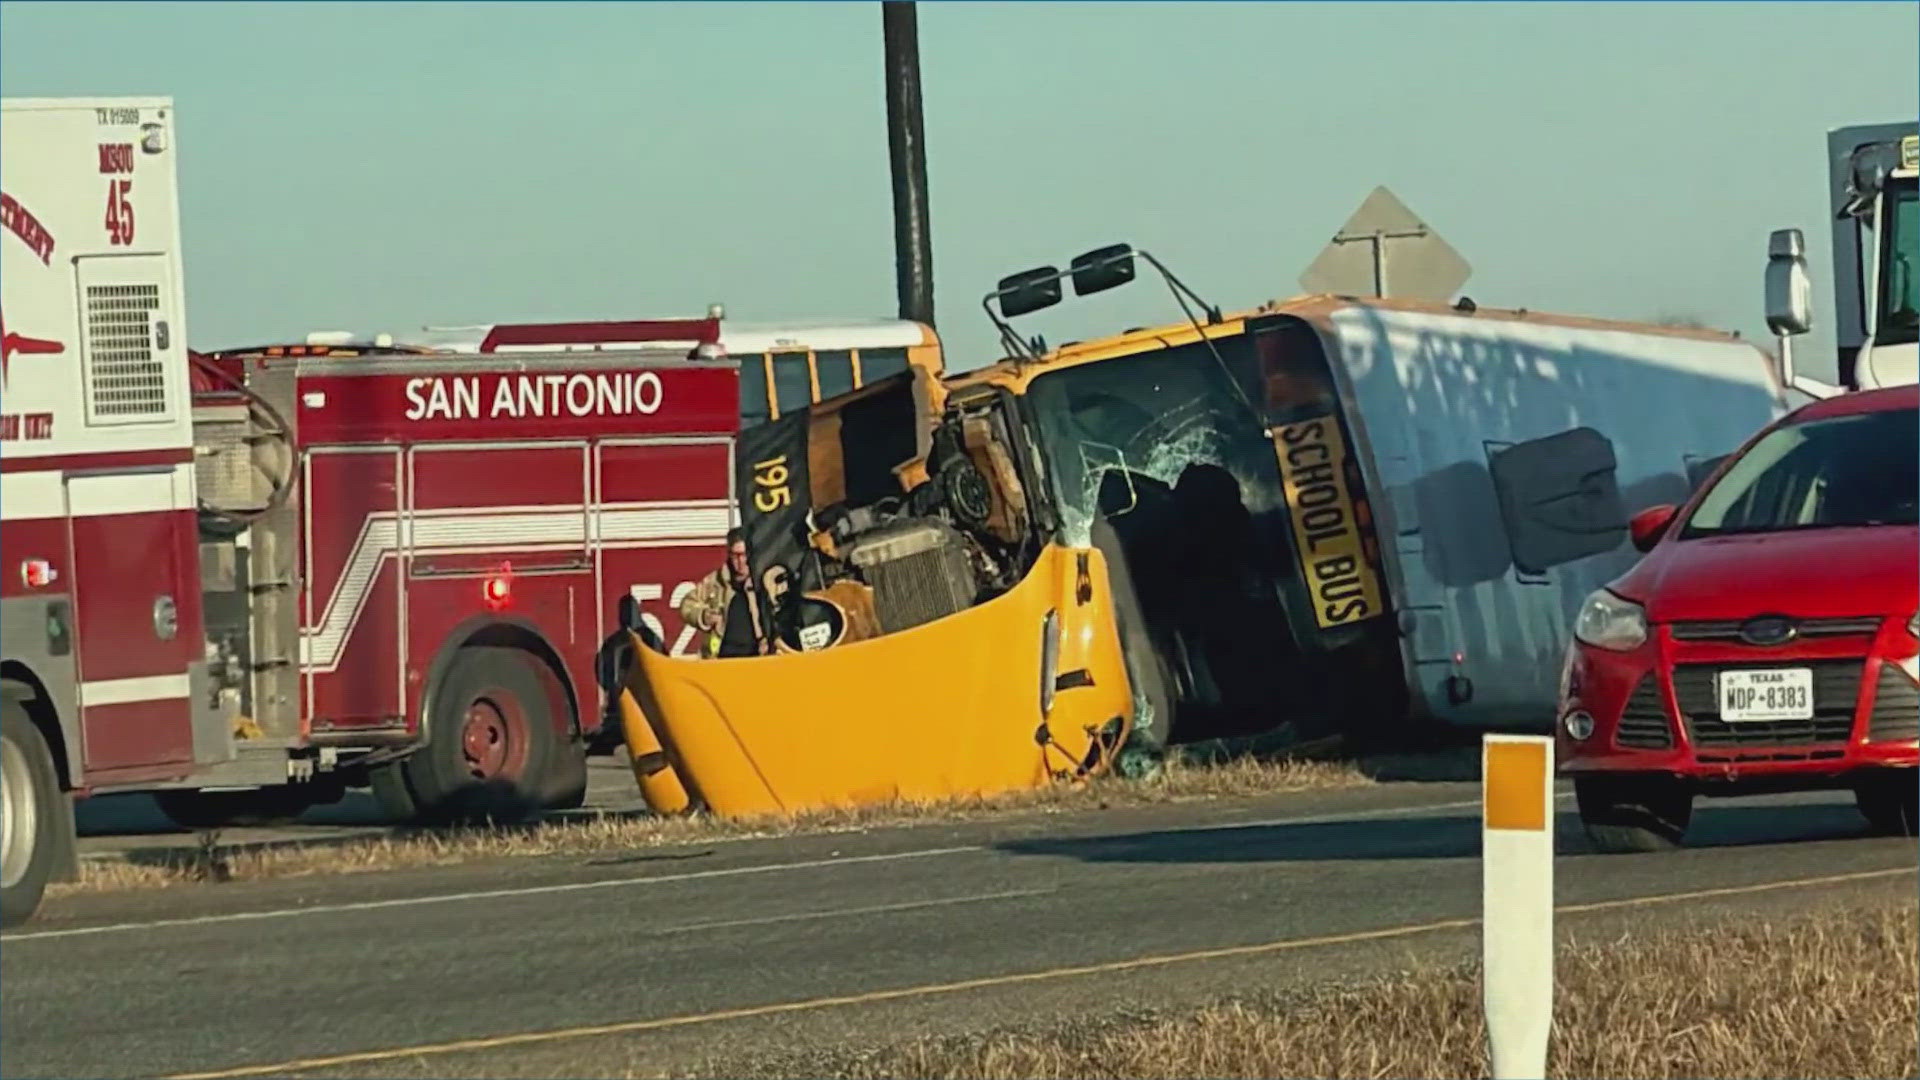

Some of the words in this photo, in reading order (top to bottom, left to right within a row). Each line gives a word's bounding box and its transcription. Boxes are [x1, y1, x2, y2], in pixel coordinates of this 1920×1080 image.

[104, 179, 134, 245] 45
[405, 374, 480, 421] SAN
[490, 371, 663, 419] ANTONIO
[754, 455, 791, 512] 195
[1283, 421, 1349, 554] SCHOOL
[1313, 555, 1369, 622] BUS
[1750, 673, 1784, 683] TEXAS
